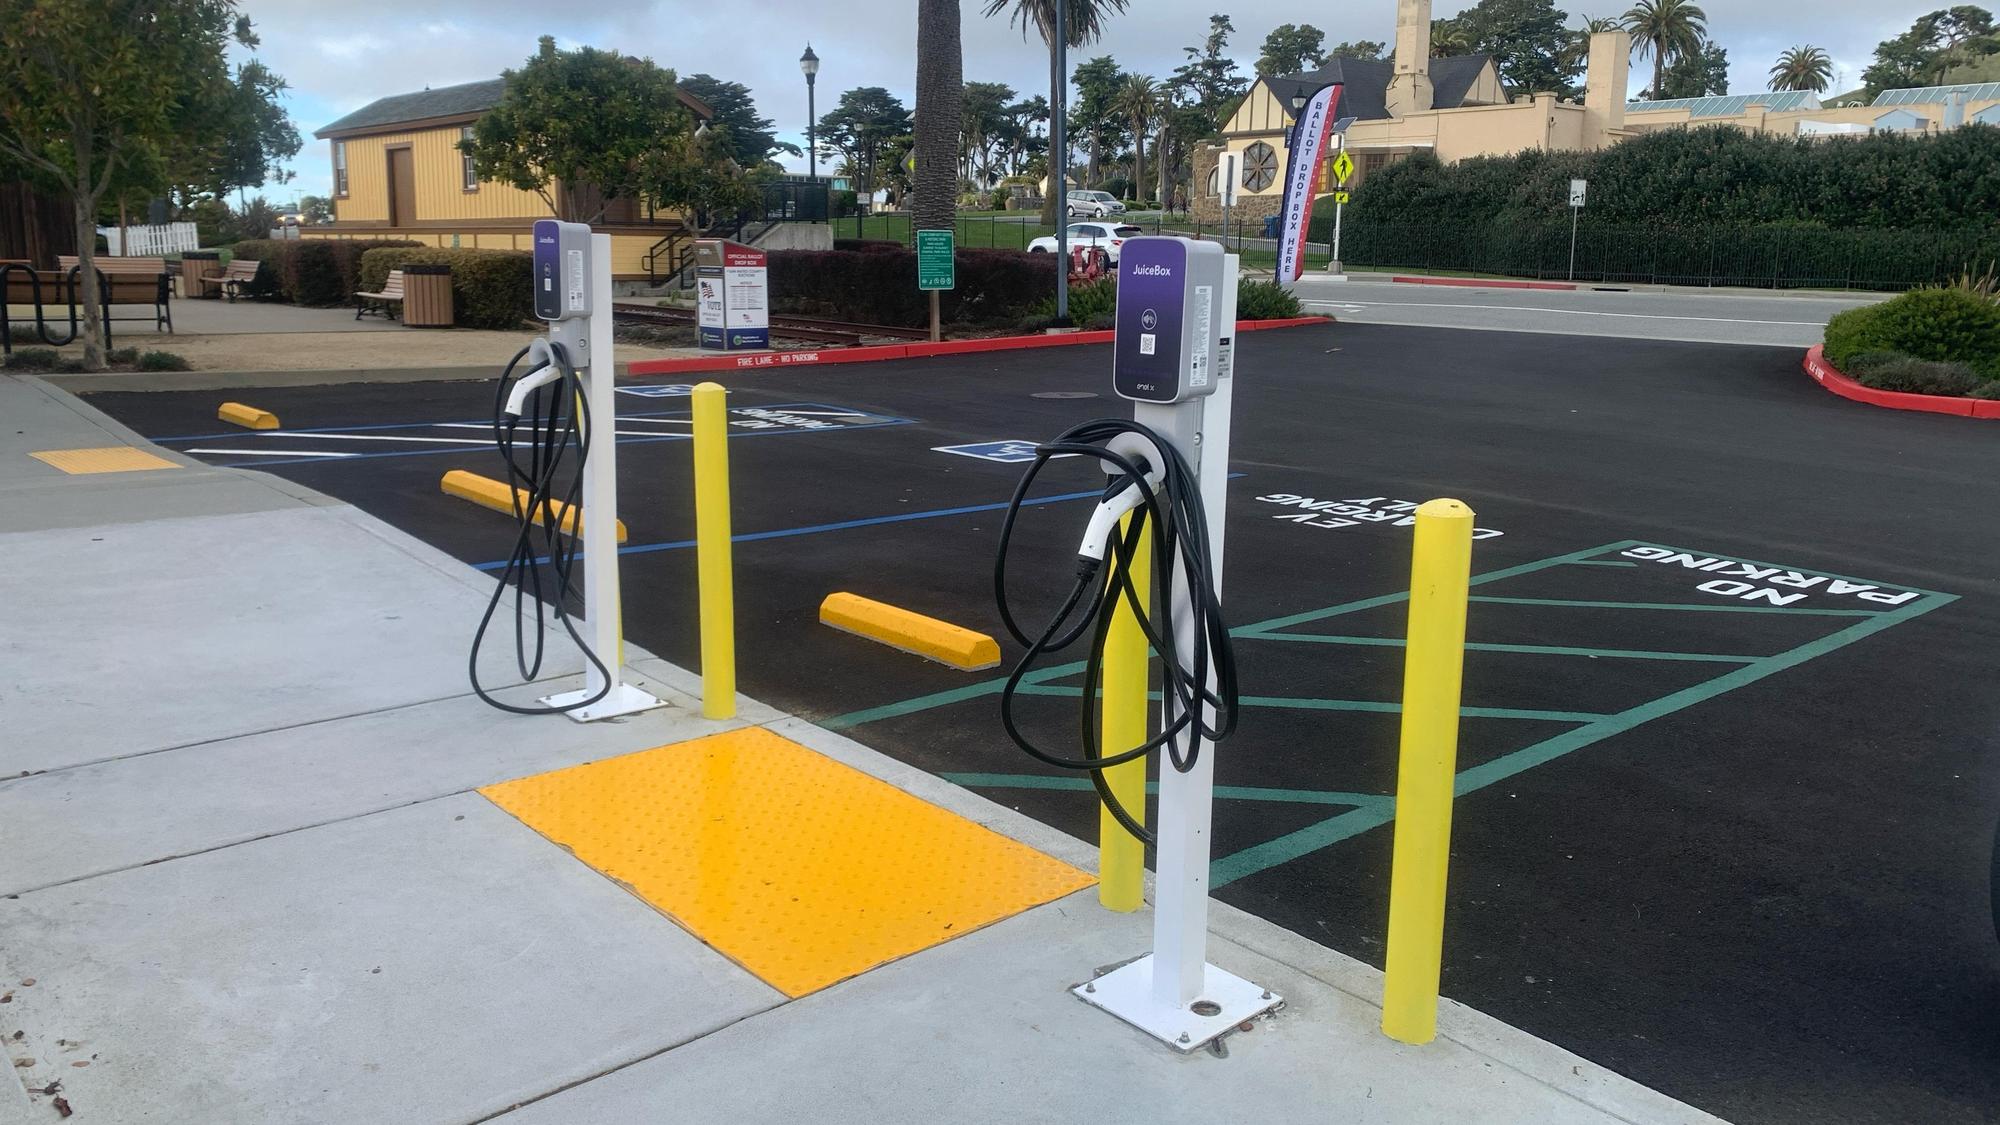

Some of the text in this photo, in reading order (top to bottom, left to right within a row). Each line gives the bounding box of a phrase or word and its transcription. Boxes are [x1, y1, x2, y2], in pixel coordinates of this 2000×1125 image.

[1284, 101, 1323, 273] BALLOT DROP BOX HERE
[1132, 264, 1171, 277] JuiceBox
[737, 357, 754, 366] FIRE
[755, 355, 773, 365] LANE
[780, 355, 791, 363] NO
[791, 353, 819, 362] PARKING
[1255, 493, 1505, 540] CARGING
[1272, 513, 1362, 529] EV
[1621, 546, 1920, 605] PARKING
[1695, 579, 1808, 606] NO
